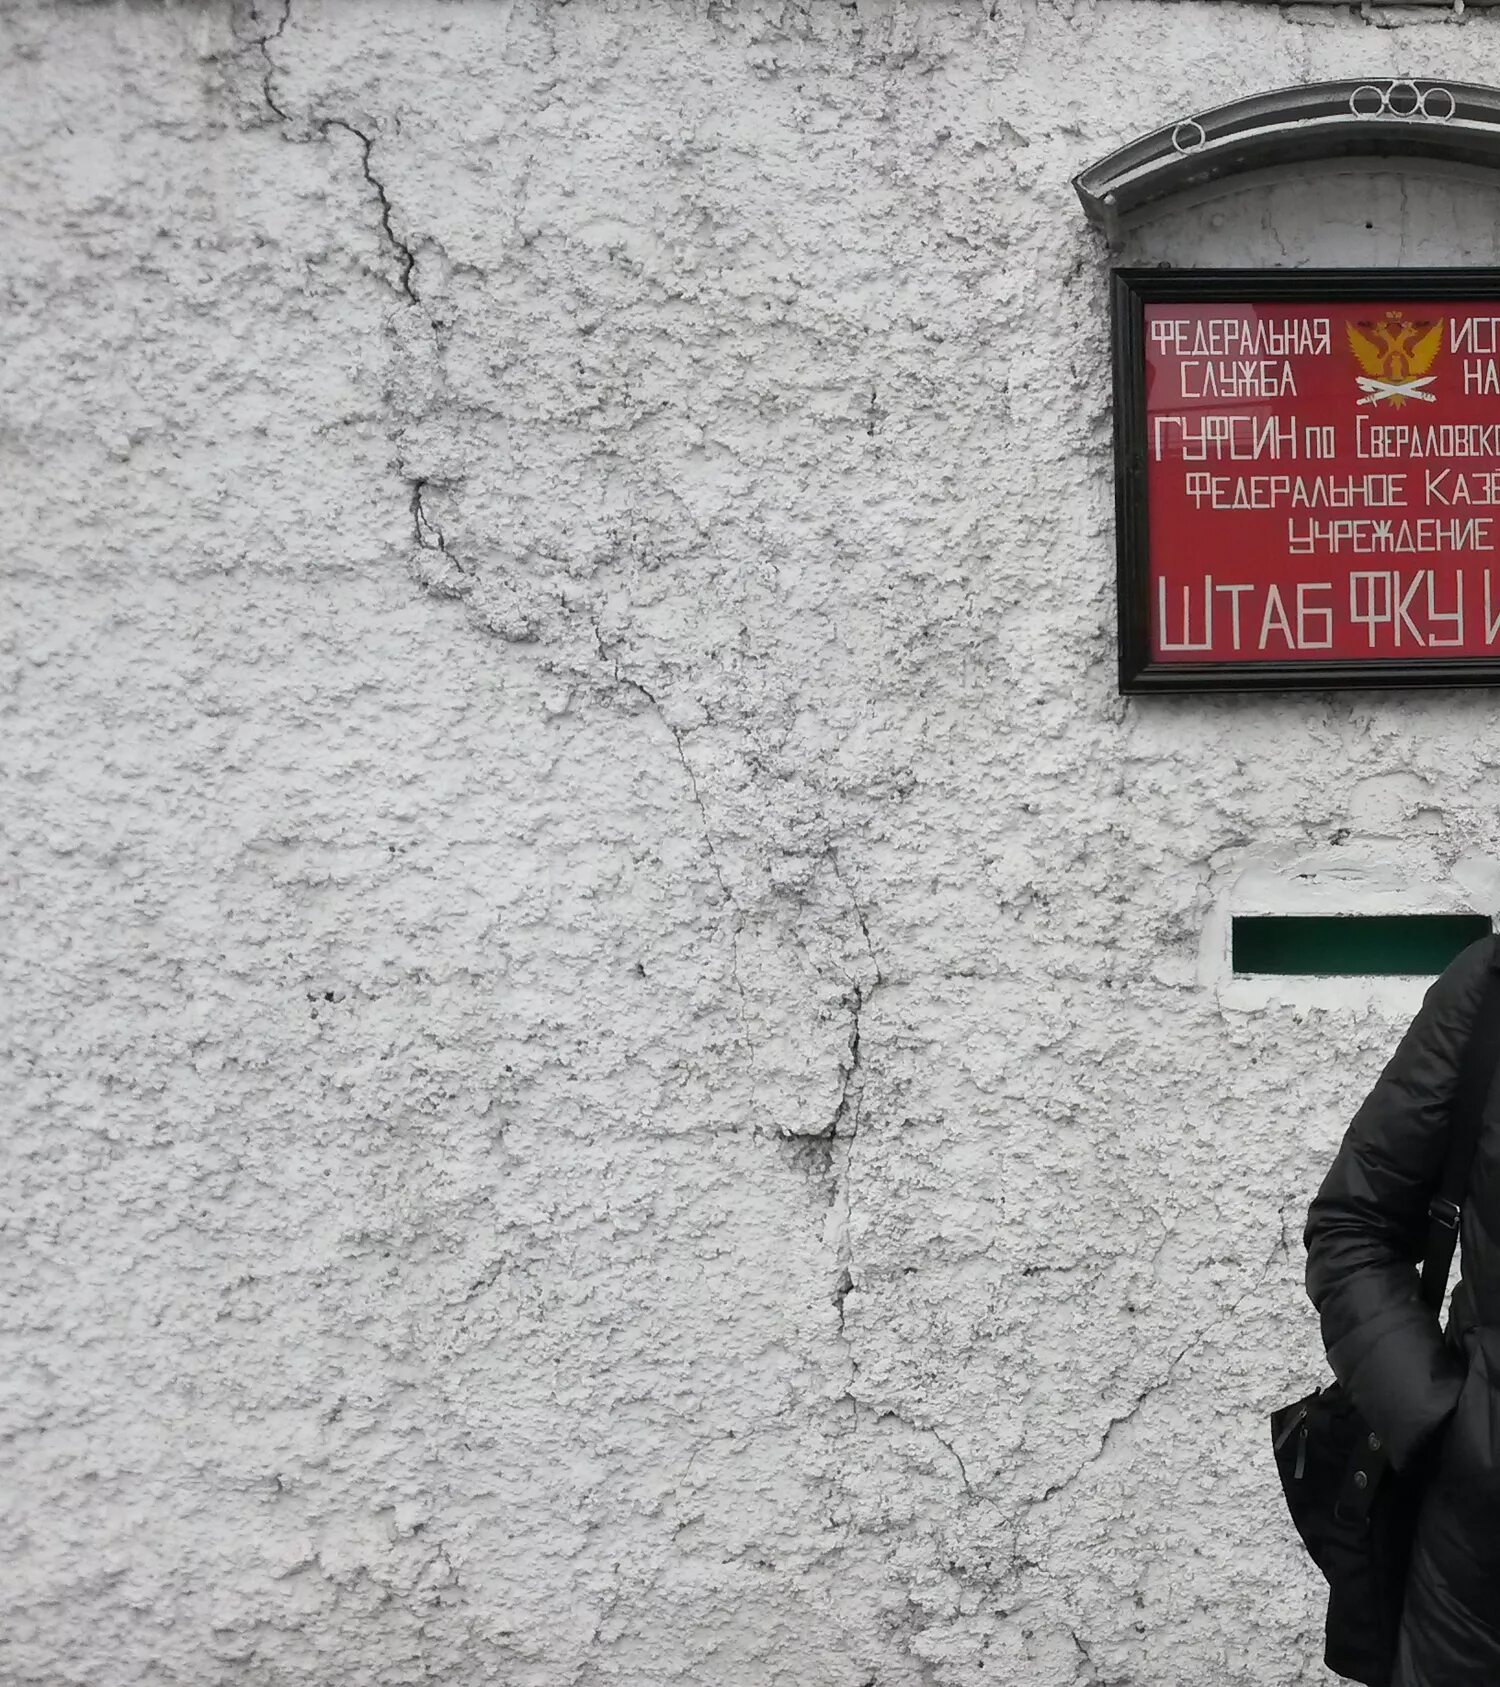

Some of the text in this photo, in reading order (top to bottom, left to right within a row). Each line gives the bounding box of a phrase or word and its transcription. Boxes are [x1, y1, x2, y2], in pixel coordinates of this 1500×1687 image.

[1150, 318, 1332, 357] ФЕДЕРАЛЬНАЯ
[1180, 360, 1297, 398] СЛУЖБА
[1154, 415, 1297, 461] ГУФСИН
[1185, 472, 1408, 510] ФЕДЕРАЛЬНОЕ
[1288, 517, 1494, 554] УЧРЕЖДЕНИЕ
[1158, 574, 1333, 651] ШТАБ
[1349, 569, 1464, 648] ФКУ
